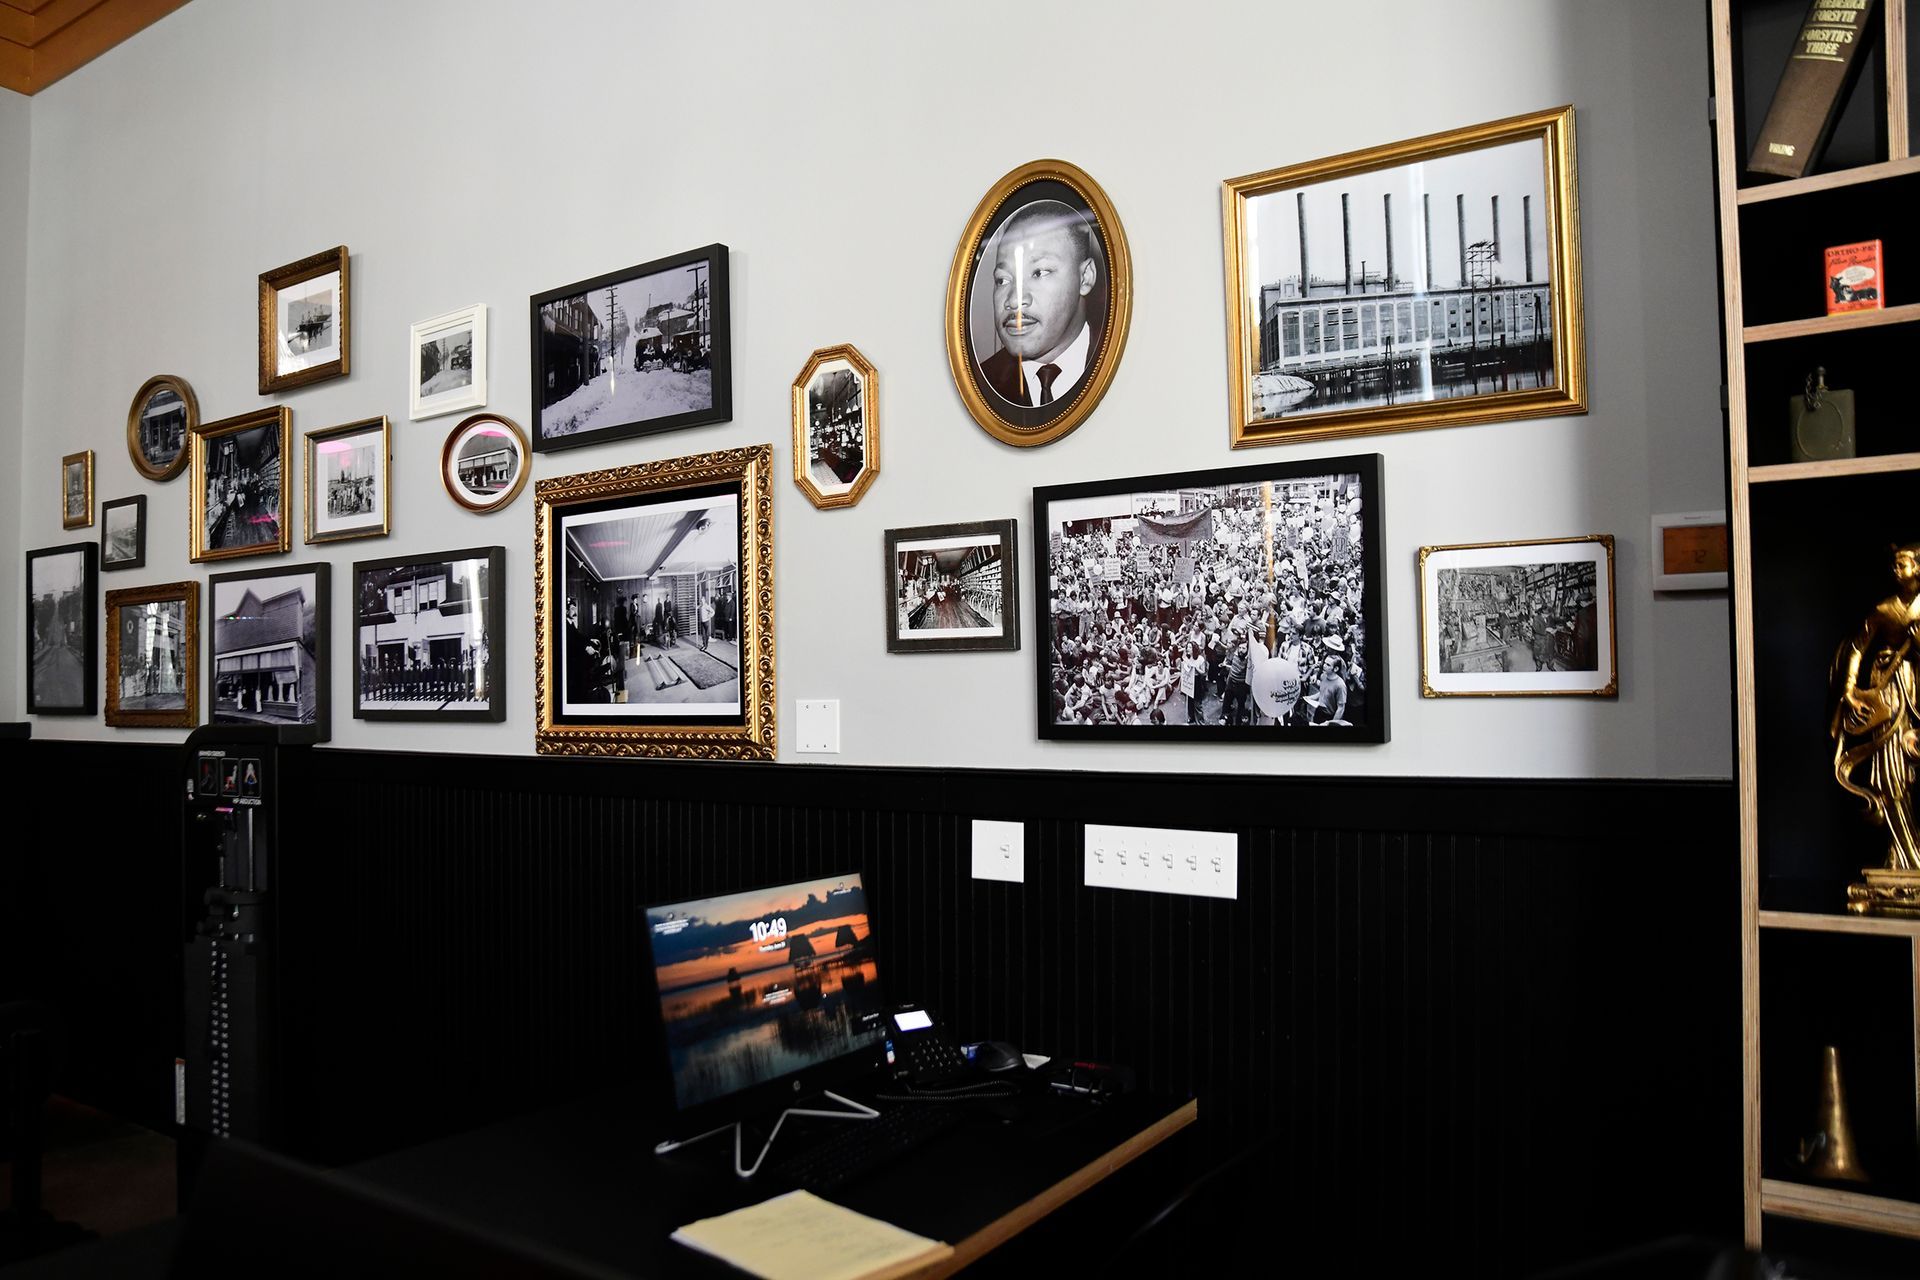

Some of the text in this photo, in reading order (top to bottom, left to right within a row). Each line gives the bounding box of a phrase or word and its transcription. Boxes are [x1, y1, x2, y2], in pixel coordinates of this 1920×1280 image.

[1812, 9, 1857, 22] FORSYTH
[1801, 28, 1853, 43] FORSYTH'S
[1806, 42, 1840, 55] THREE
[1769, 142, 1795, 156] VIKING
[749, 917, 787, 942] 10:49
